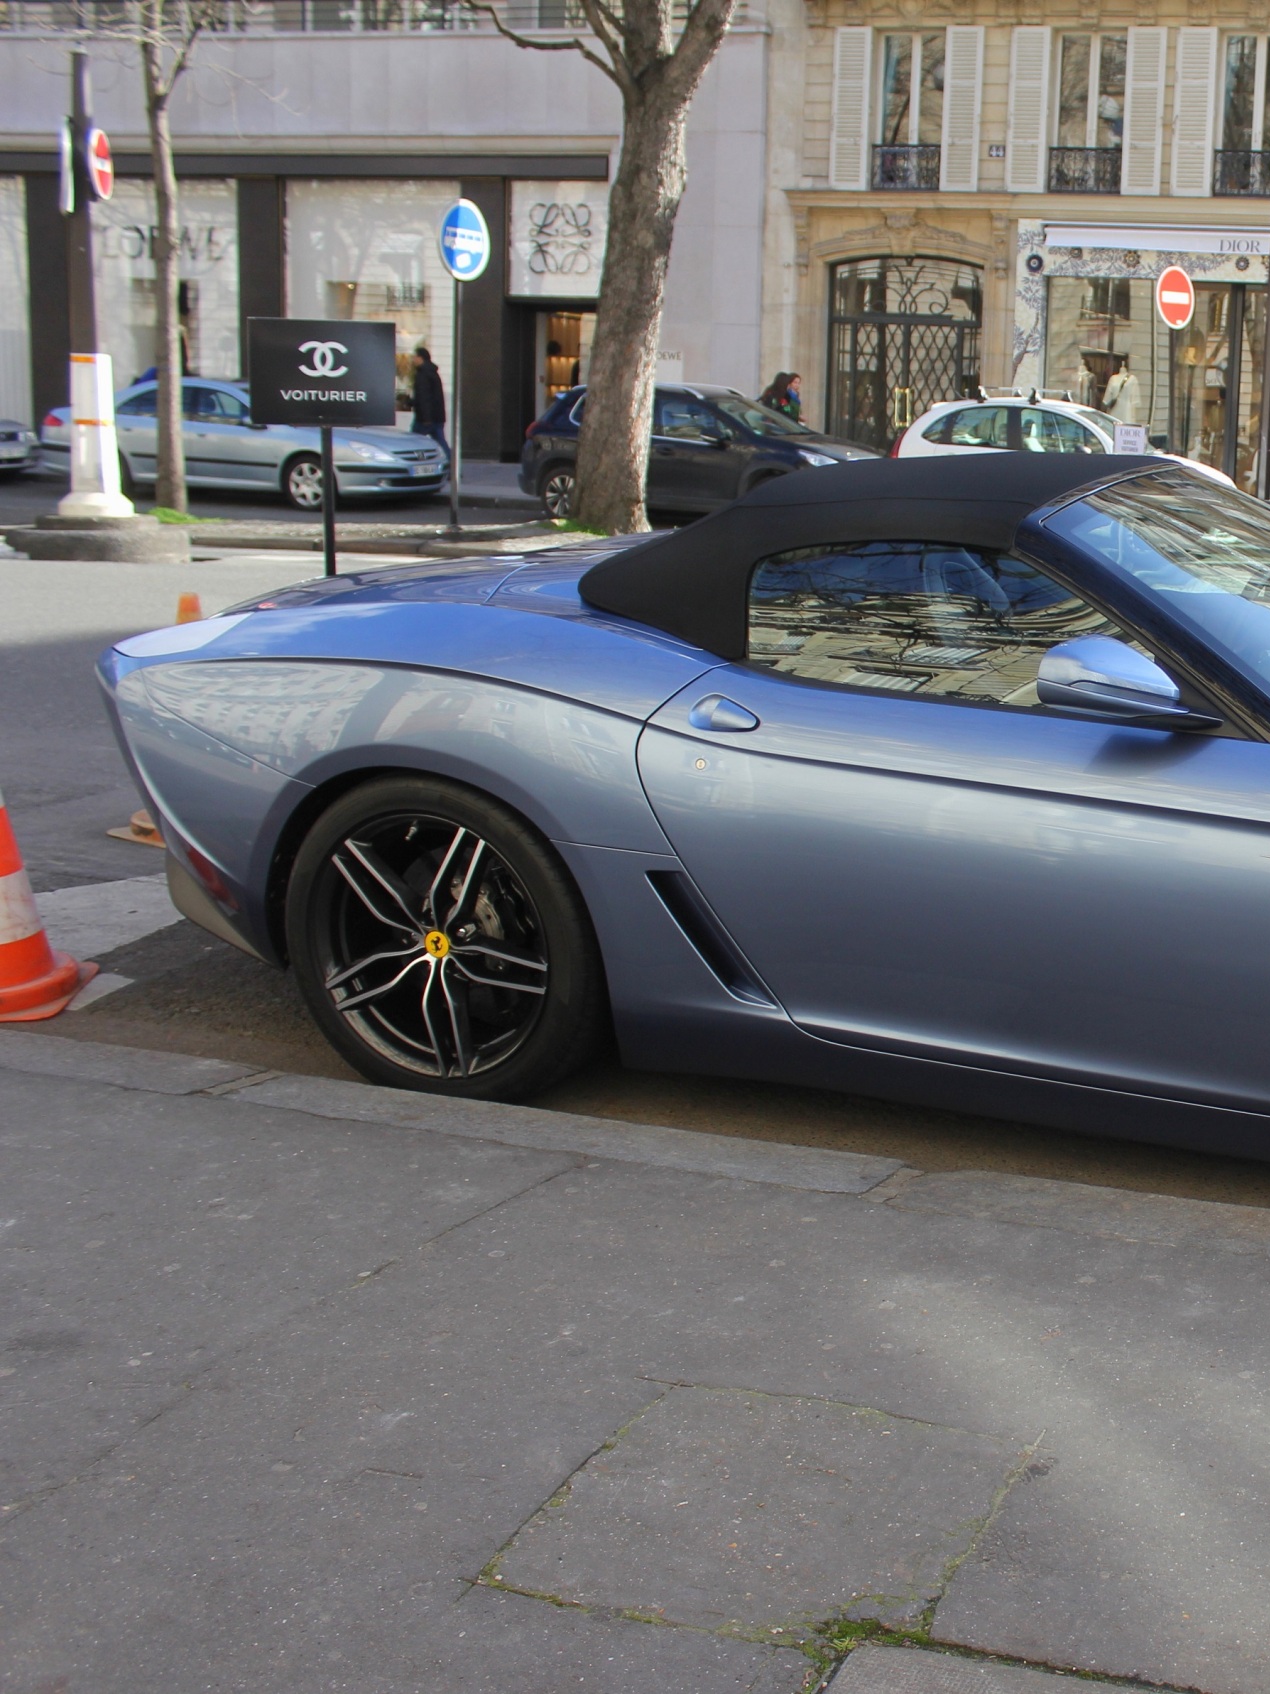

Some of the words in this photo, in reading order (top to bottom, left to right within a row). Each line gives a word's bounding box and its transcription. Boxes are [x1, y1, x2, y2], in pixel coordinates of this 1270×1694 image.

[1219, 239, 1261, 252] DIOR
[281, 389, 367, 402] VOITURIER
[1120, 428, 1141, 437] DIOR
